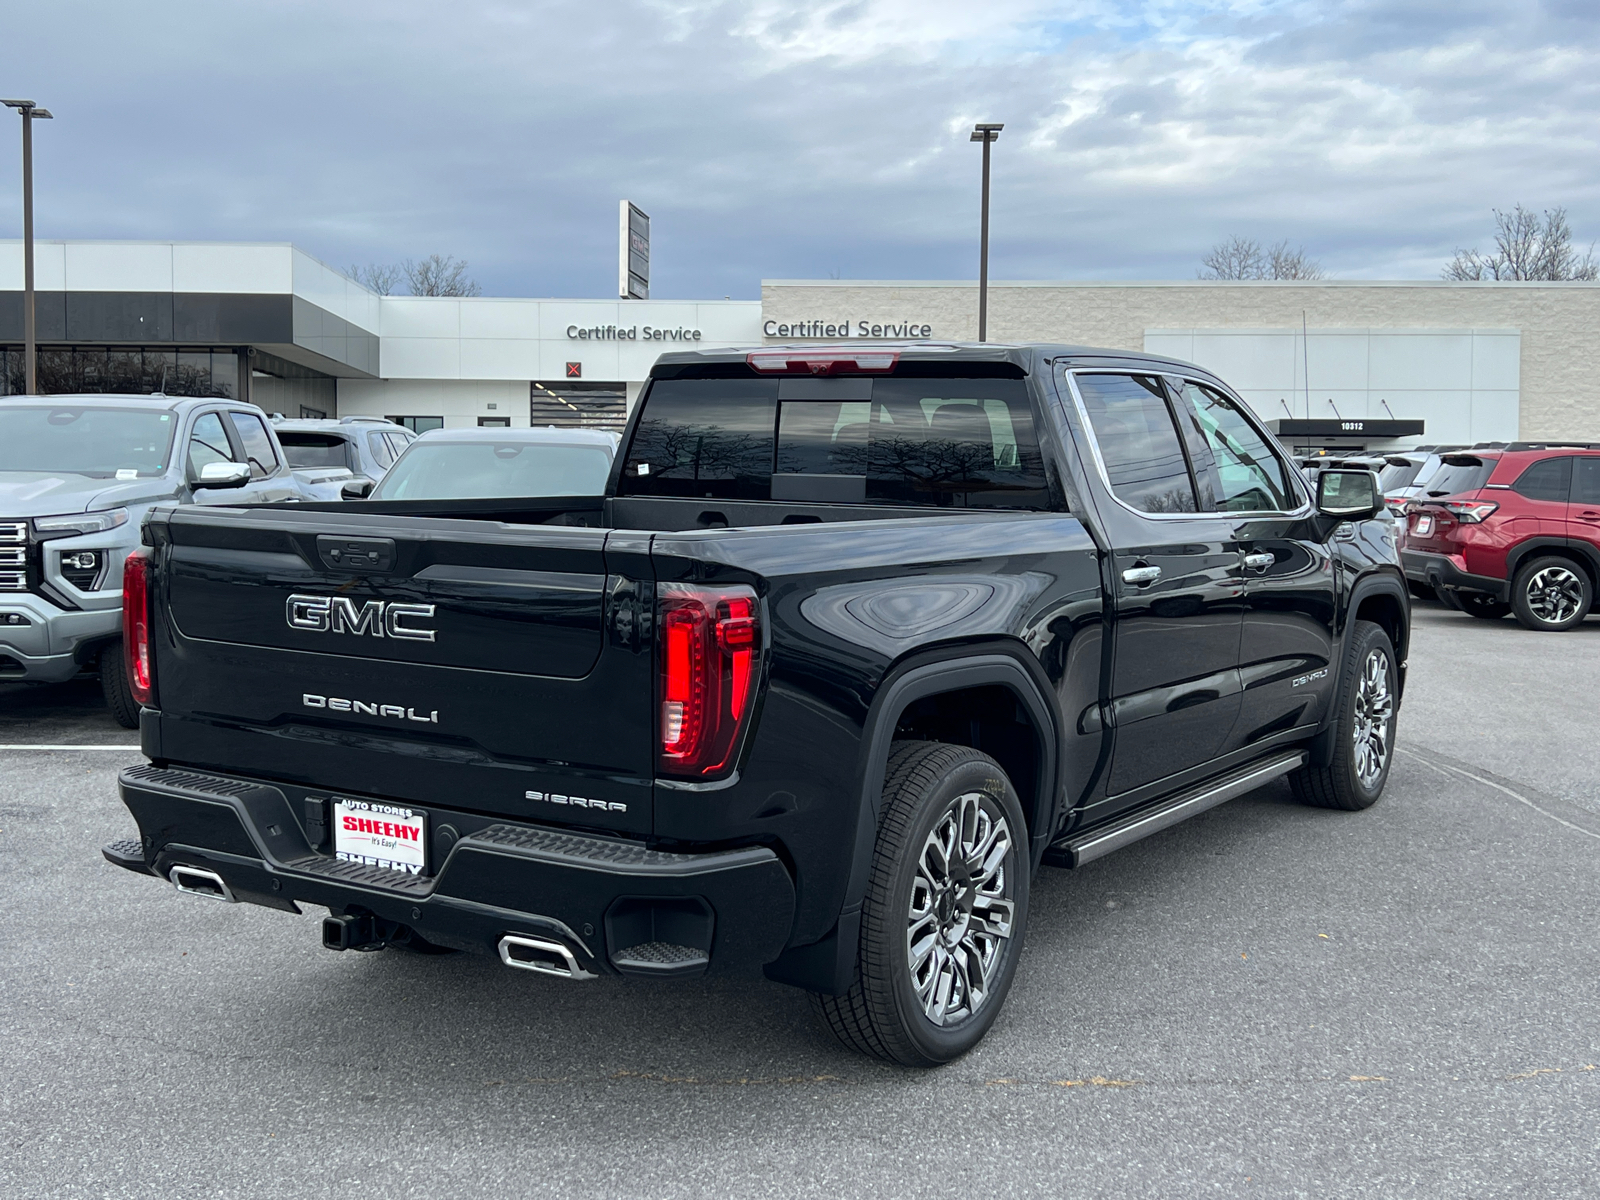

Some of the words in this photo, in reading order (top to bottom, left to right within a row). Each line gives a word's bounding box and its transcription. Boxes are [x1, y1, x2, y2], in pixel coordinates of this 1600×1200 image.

[566, 325, 637, 340] Certified
[642, 326, 702, 340] Service
[763, 320, 849, 337] Certified
[857, 321, 932, 337] Service
[1341, 422, 1363, 430] 10312
[285, 593, 438, 643] GMC
[302, 693, 439, 724] DENALI
[341, 799, 369, 811] AUTO
[371, 804, 413, 817] STORES
[525, 790, 627, 814] SIERRA
[343, 816, 420, 842] SHEEHY
[371, 836, 380, 846] It's
[381, 838, 397, 850] Easy!
